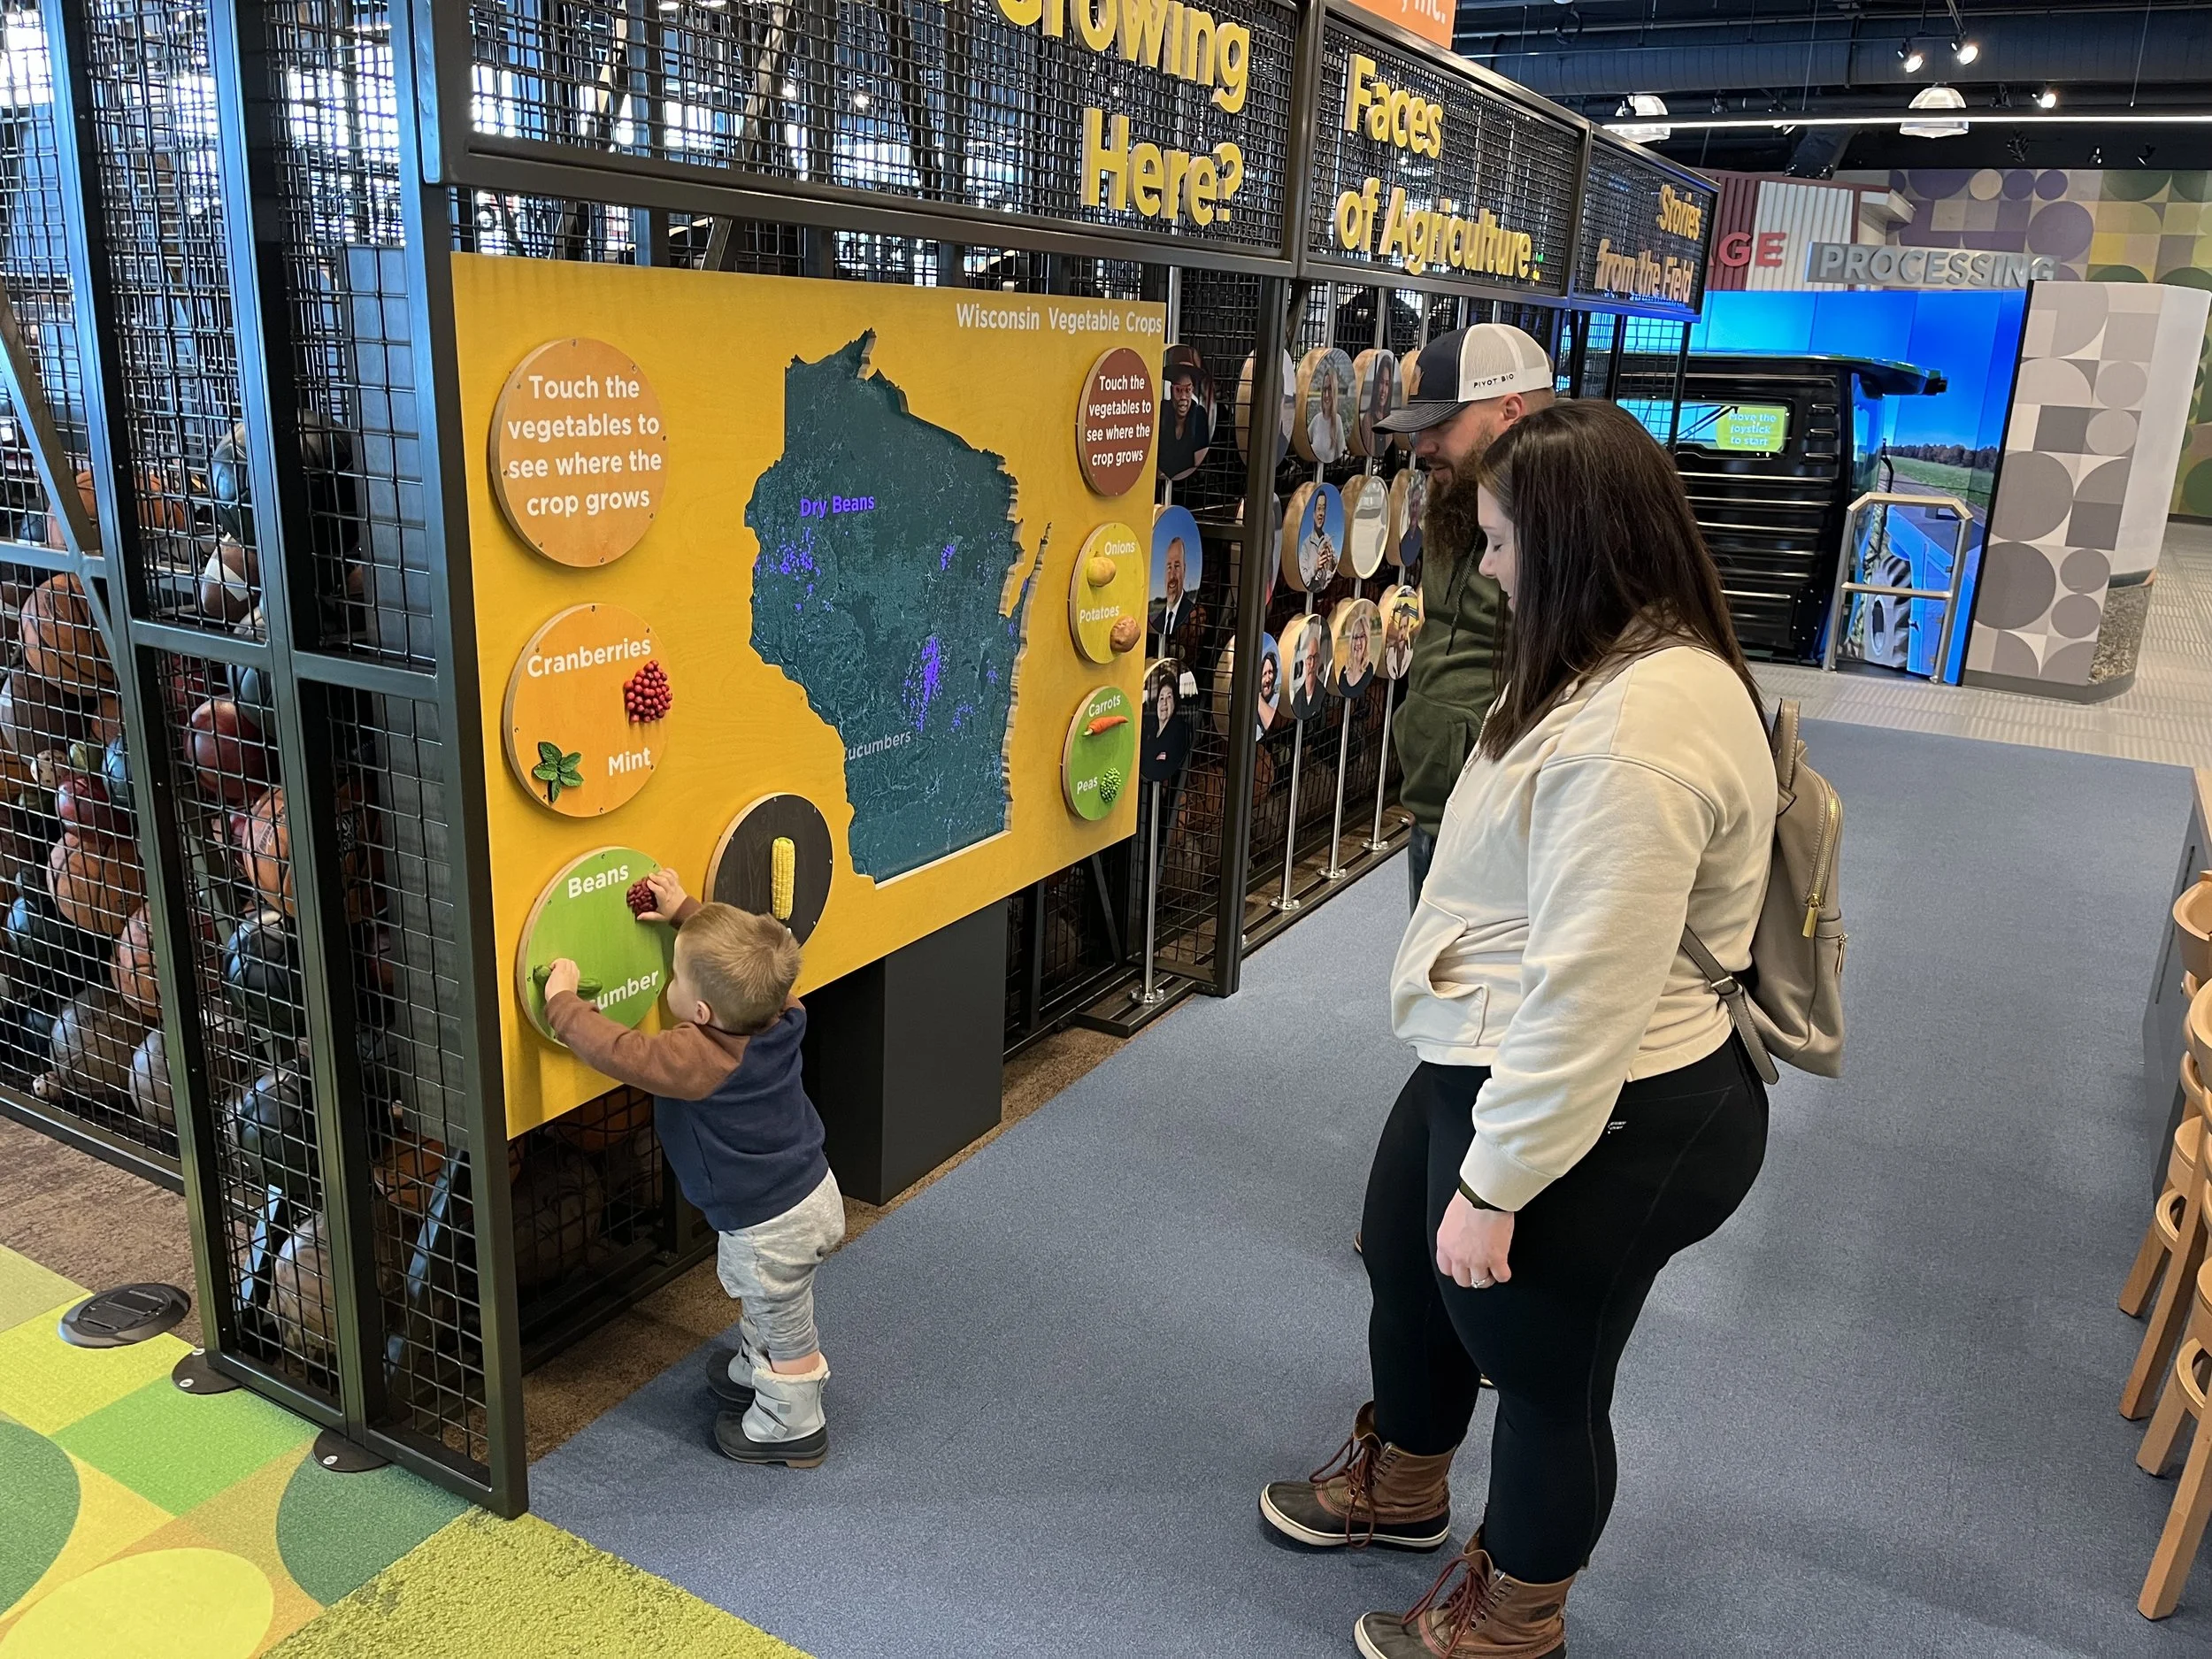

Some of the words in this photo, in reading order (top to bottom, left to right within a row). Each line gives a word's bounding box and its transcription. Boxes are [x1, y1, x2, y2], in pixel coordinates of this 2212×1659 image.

[1344, 53, 1443, 158] Faces
[1080, 107, 1242, 226] Here?
[1656, 184, 1701, 241] Stories
[1335, 178, 1380, 251] of
[1379, 187, 1532, 279] Agriculture
[1709, 232, 1786, 268] GE
[1594, 238, 1636, 293] from
[1636, 250, 1661, 296] the
[1662, 256, 1694, 303] Field
[1818, 244, 2055, 288] PROCESSING
[956, 303, 1040, 331] Wisconsin
[1048, 306, 1120, 334] Vegetable
[1125, 311, 1163, 336] Crops
[528, 374, 599, 399] Touch
[605, 374, 640, 398] the
[1099, 374, 1128, 391] Touch
[1130, 374, 1145, 390] the
[1473, 378, 1498, 388] PIVOT
[1501, 373, 1514, 382] BIO
[1088, 399, 1140, 419] vegetables
[1141, 399, 1151, 413] to
[1759, 413, 1777, 423] the
[507, 412, 632, 442] vegetables
[638, 413, 660, 435] to
[1087, 426, 1103, 442] see
[1105, 424, 1133, 441] where
[1135, 422, 1151, 438] the
[1731, 436, 1741, 445] to
[1744, 437, 1769, 446] start
[508, 457, 549, 480] see
[555, 451, 623, 476] where
[629, 449, 662, 472] the
[1091, 452, 1113, 468] crop
[1116, 449, 1144, 467] grows
[526, 494, 579, 518] crop
[585, 489, 650, 516] grows
[800, 496, 827, 518] Dry
[832, 494, 875, 514] Beans
[1104, 540, 1136, 556] Onions
[1079, 605, 1120, 624] Potatoes
[526, 637, 651, 678] Cranberries
[1088, 694, 1121, 718] Carrots
[844, 731, 911, 762] ucumbers
[608, 747, 651, 777] Mint
[1077, 775, 1098, 795] Peas
[567, 864, 630, 899] Beans
